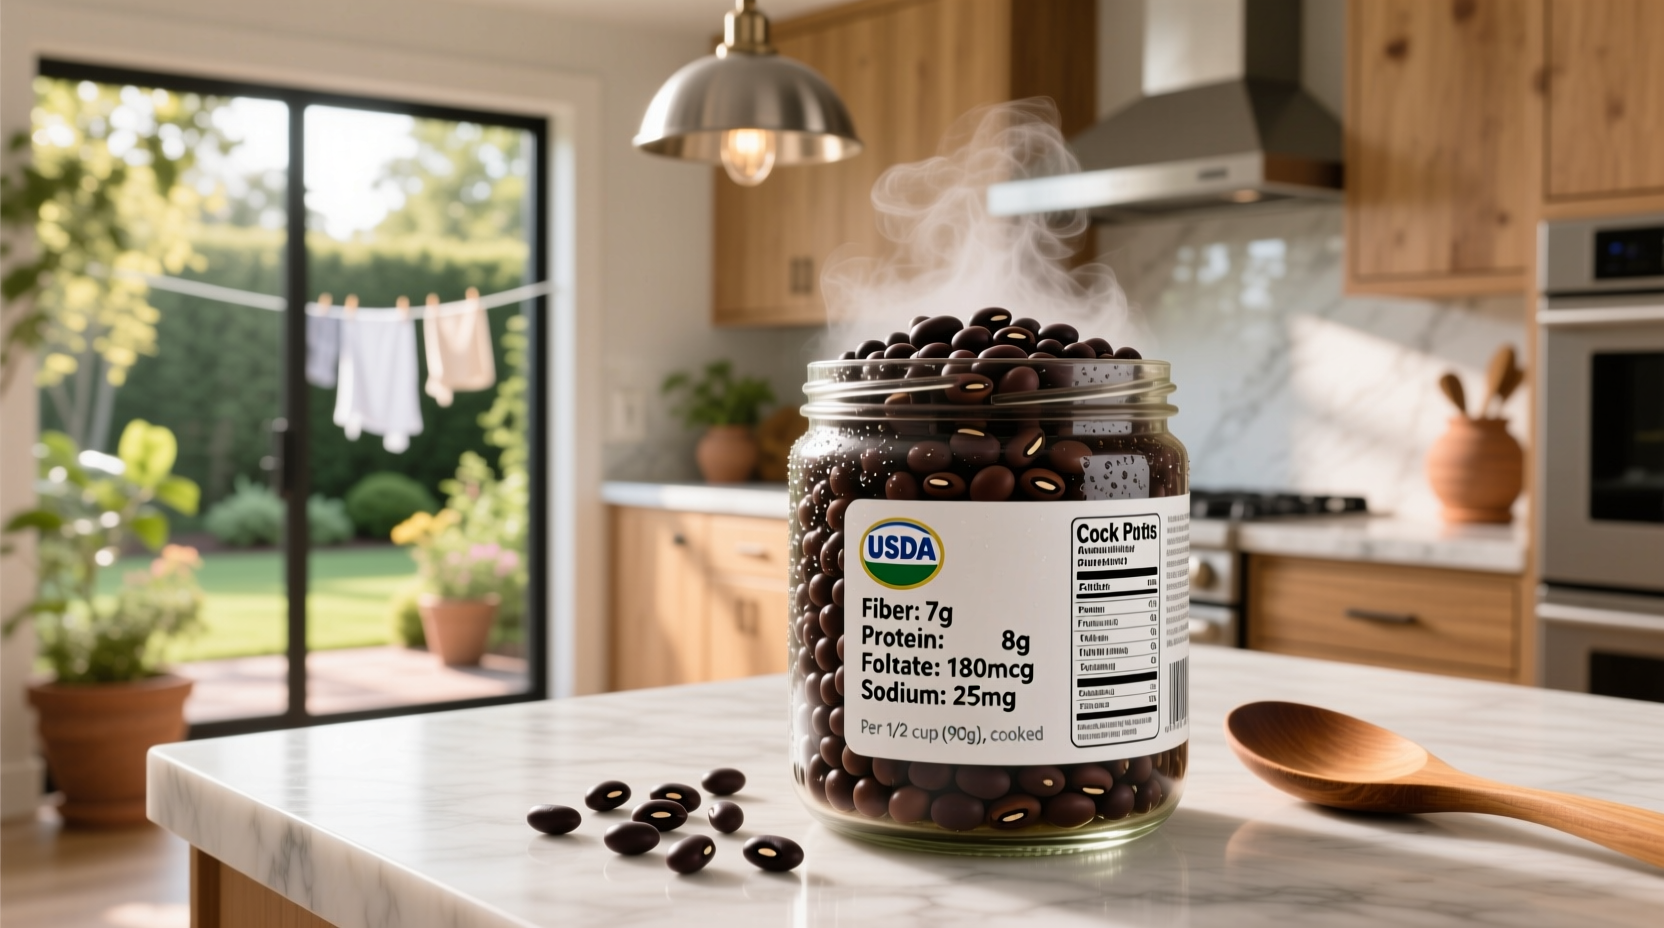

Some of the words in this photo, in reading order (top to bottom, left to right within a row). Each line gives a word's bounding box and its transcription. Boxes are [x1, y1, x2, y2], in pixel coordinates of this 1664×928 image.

[868, 535, 936, 561] USDA
[1077, 523, 1119, 543] Cock
[862, 597, 920, 621] Fiber:
[926, 601, 953, 628] 7g
[862, 625, 944, 649] Protein:
[1001, 630, 1030, 656] 8g
[862, 652, 940, 677] Foltate:
[947, 657, 1034, 684] 180mcg
[861, 679, 946, 705] Sodium:
[953, 685, 1016, 712] 25mg
[861, 719, 882, 734] Per
[886, 722, 908, 739] 1/2
[912, 727, 938, 743] cup
[942, 725, 987, 745] (90g),
[990, 726, 1044, 742] cooked
